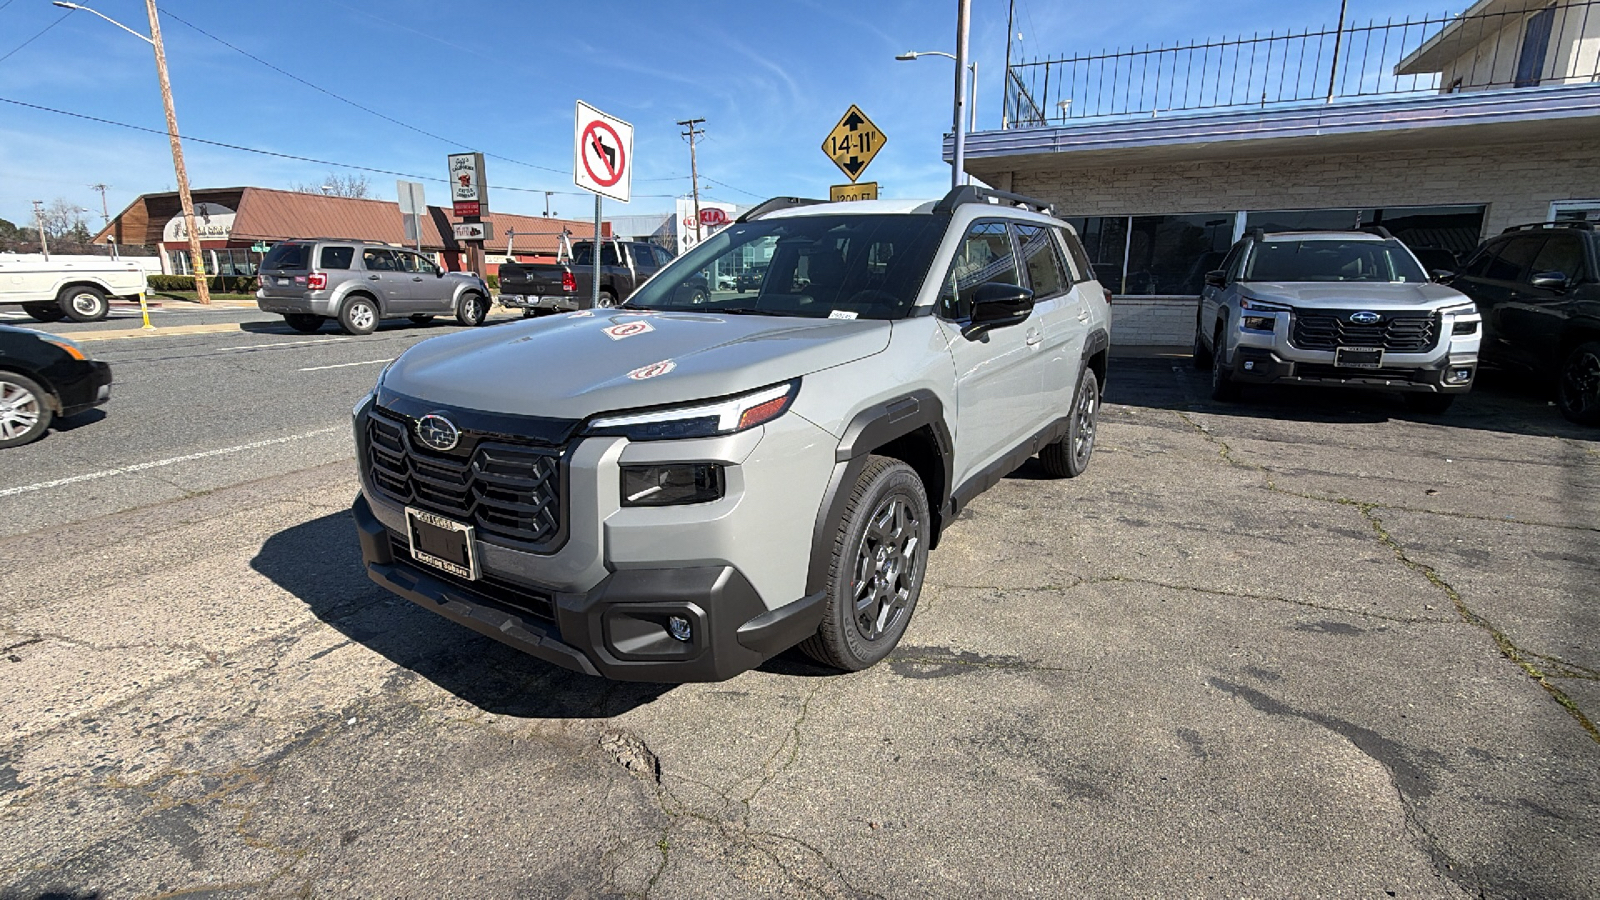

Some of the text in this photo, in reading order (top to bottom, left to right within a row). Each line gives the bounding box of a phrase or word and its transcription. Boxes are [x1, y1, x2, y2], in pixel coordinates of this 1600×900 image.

[831, 131, 876, 156] 14'-11"
[837, 193, 871, 202] 1200 FT
[700, 211, 720, 222] KIA
